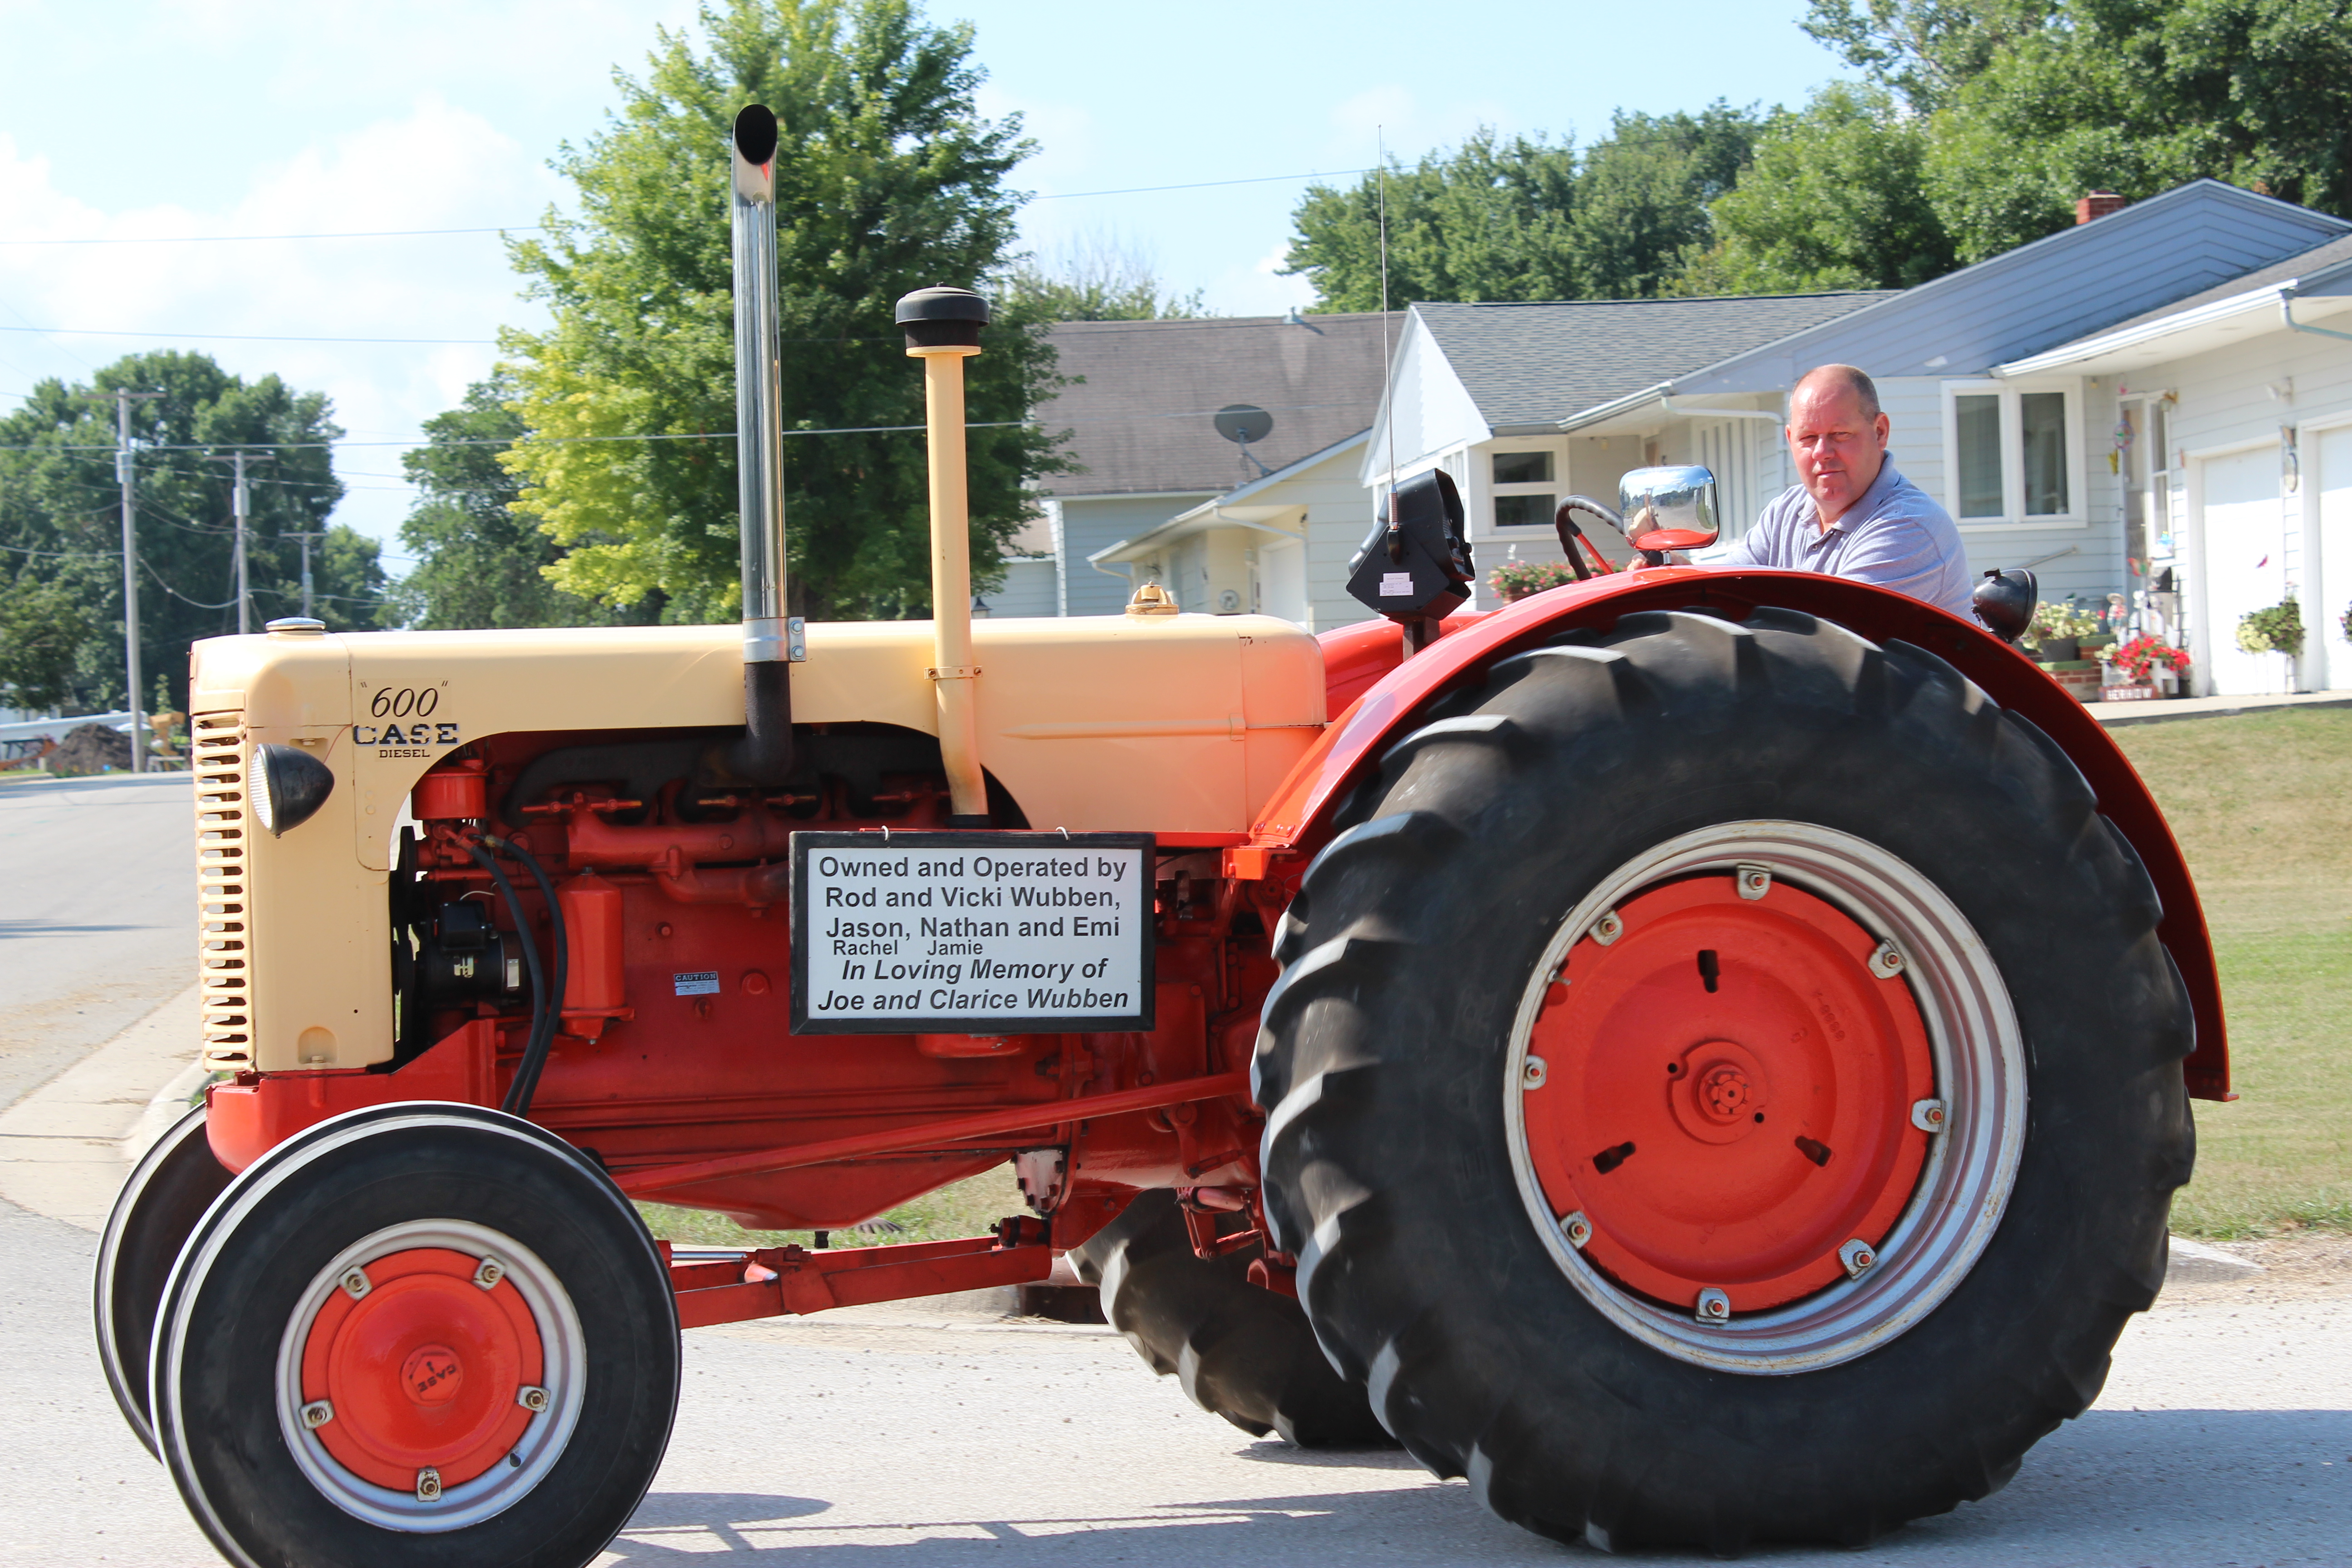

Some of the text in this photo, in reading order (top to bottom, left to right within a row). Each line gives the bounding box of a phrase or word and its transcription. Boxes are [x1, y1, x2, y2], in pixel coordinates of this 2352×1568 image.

[353, 723, 460, 745] CASE
[379, 749, 431, 758] DIESEL
[819, 856, 1127, 882] Owned and Operated by
[826, 887, 1120, 910] Rod and Vicki Wubben,
[826, 916, 1119, 941] Jason, Nathan and Emi
[833, 939, 983, 956] Rachel Jamie
[842, 958, 1109, 985] In Loving Memory of
[818, 988, 1128, 1010] Joe and Clarice Wubben
[417, 1363, 456, 1392] CASE
